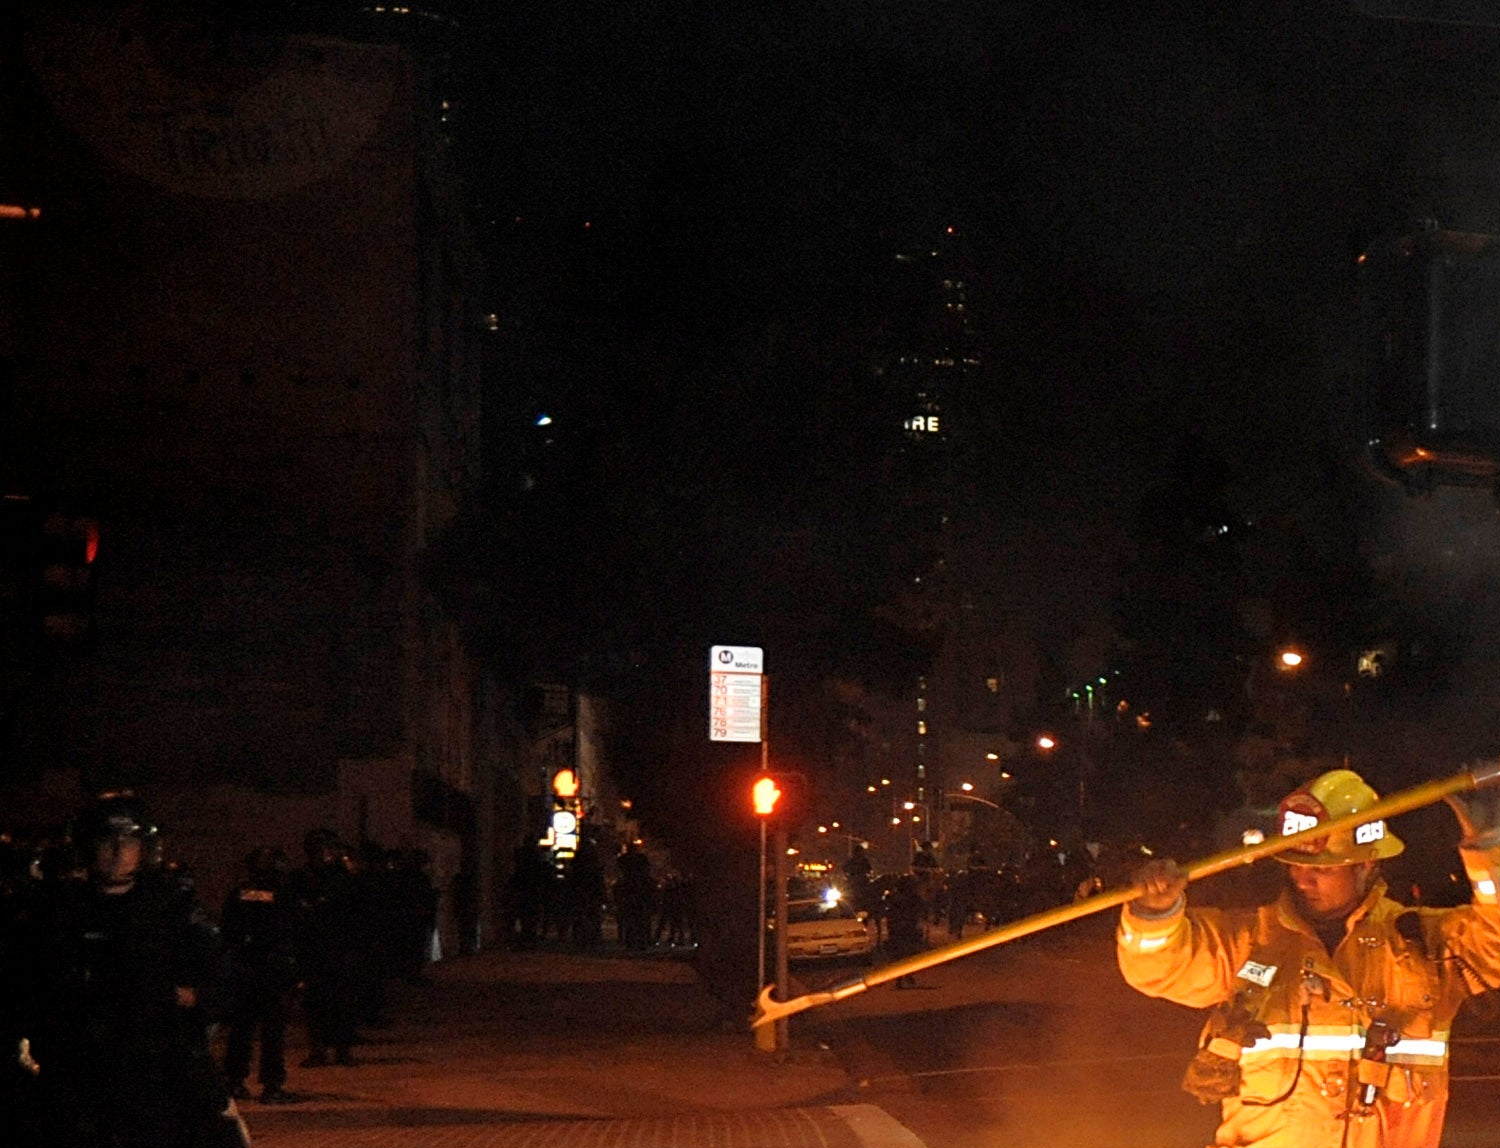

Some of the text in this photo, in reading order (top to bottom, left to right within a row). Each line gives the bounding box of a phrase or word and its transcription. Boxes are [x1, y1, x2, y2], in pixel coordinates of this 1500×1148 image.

[735, 661, 759, 669] Metro
[714, 685, 727, 694] 70
[714, 728, 727, 737] 79
